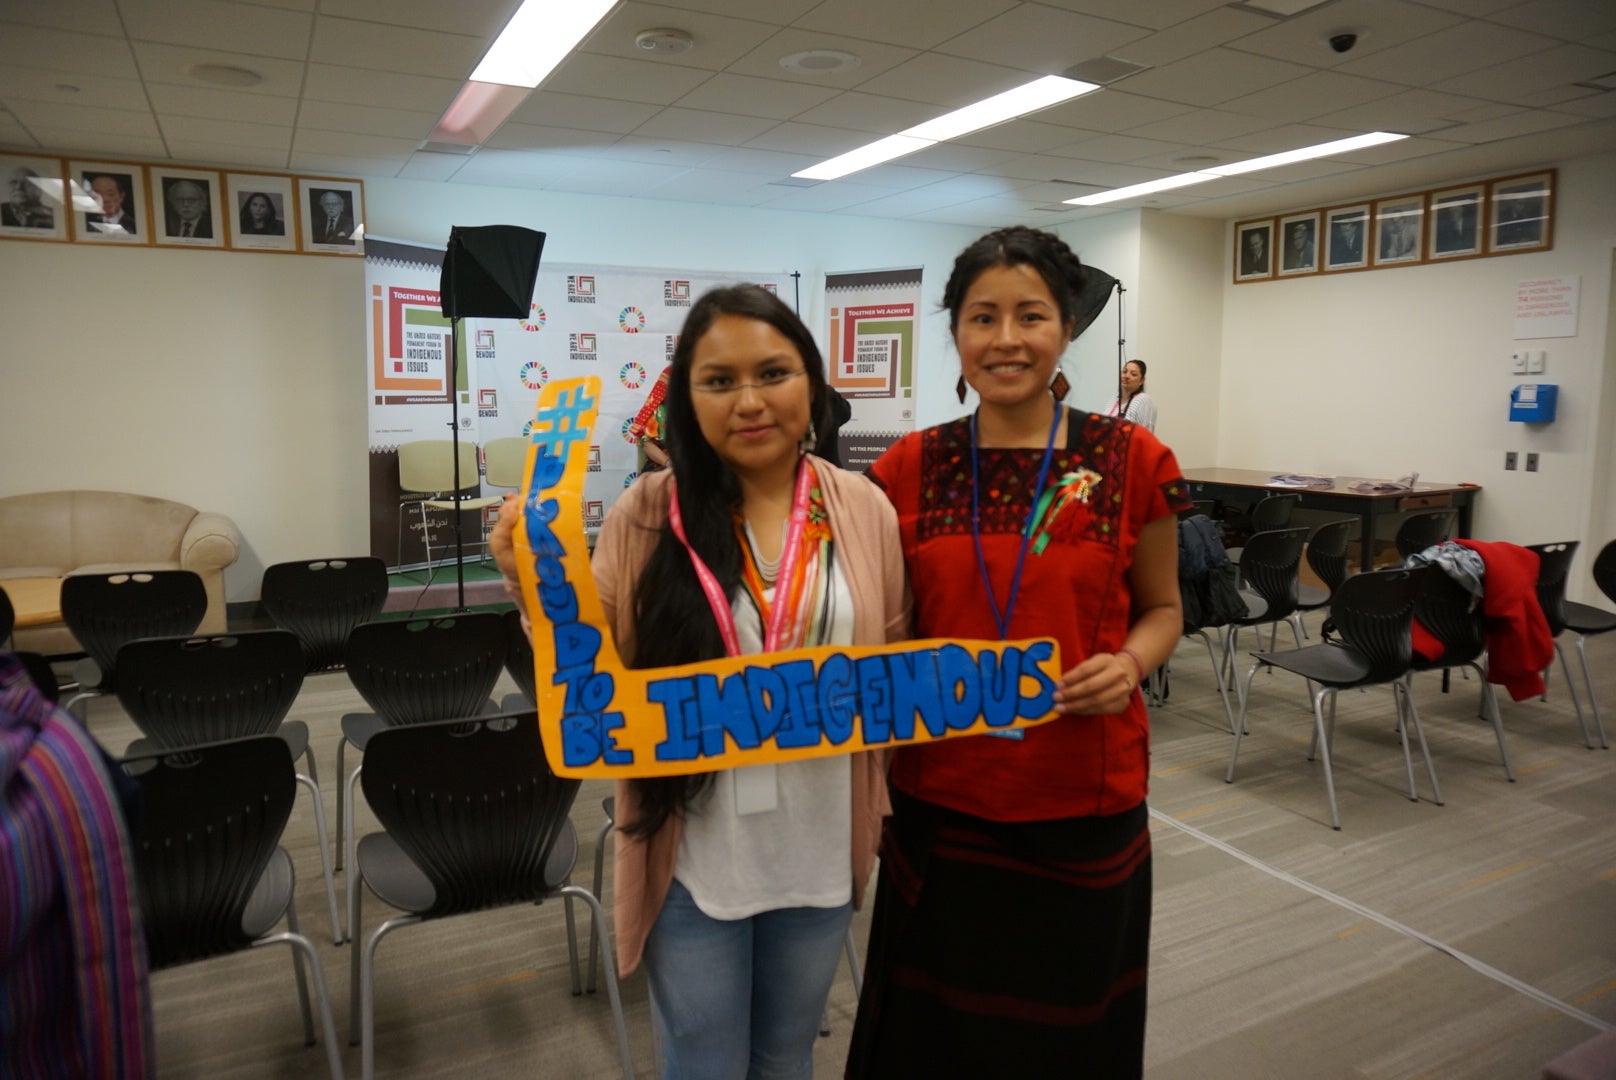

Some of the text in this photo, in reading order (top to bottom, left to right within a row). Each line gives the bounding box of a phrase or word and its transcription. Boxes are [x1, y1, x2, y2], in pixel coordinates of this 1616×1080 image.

[393, 291, 426, 302] TOGETHER
[406, 348, 442, 360] INDIGENOUS
[476, 350, 496, 358] GENOUS
[856, 353, 888, 362] INDIGENOUS
[407, 362, 428, 373] ISSUES
[856, 364, 874, 373] ISSUES
[478, 410, 498, 418] GENOUS
[552, 665, 614, 715] TO
[647, 641, 1058, 761] INDIGENOUS
[561, 711, 634, 767] BE
